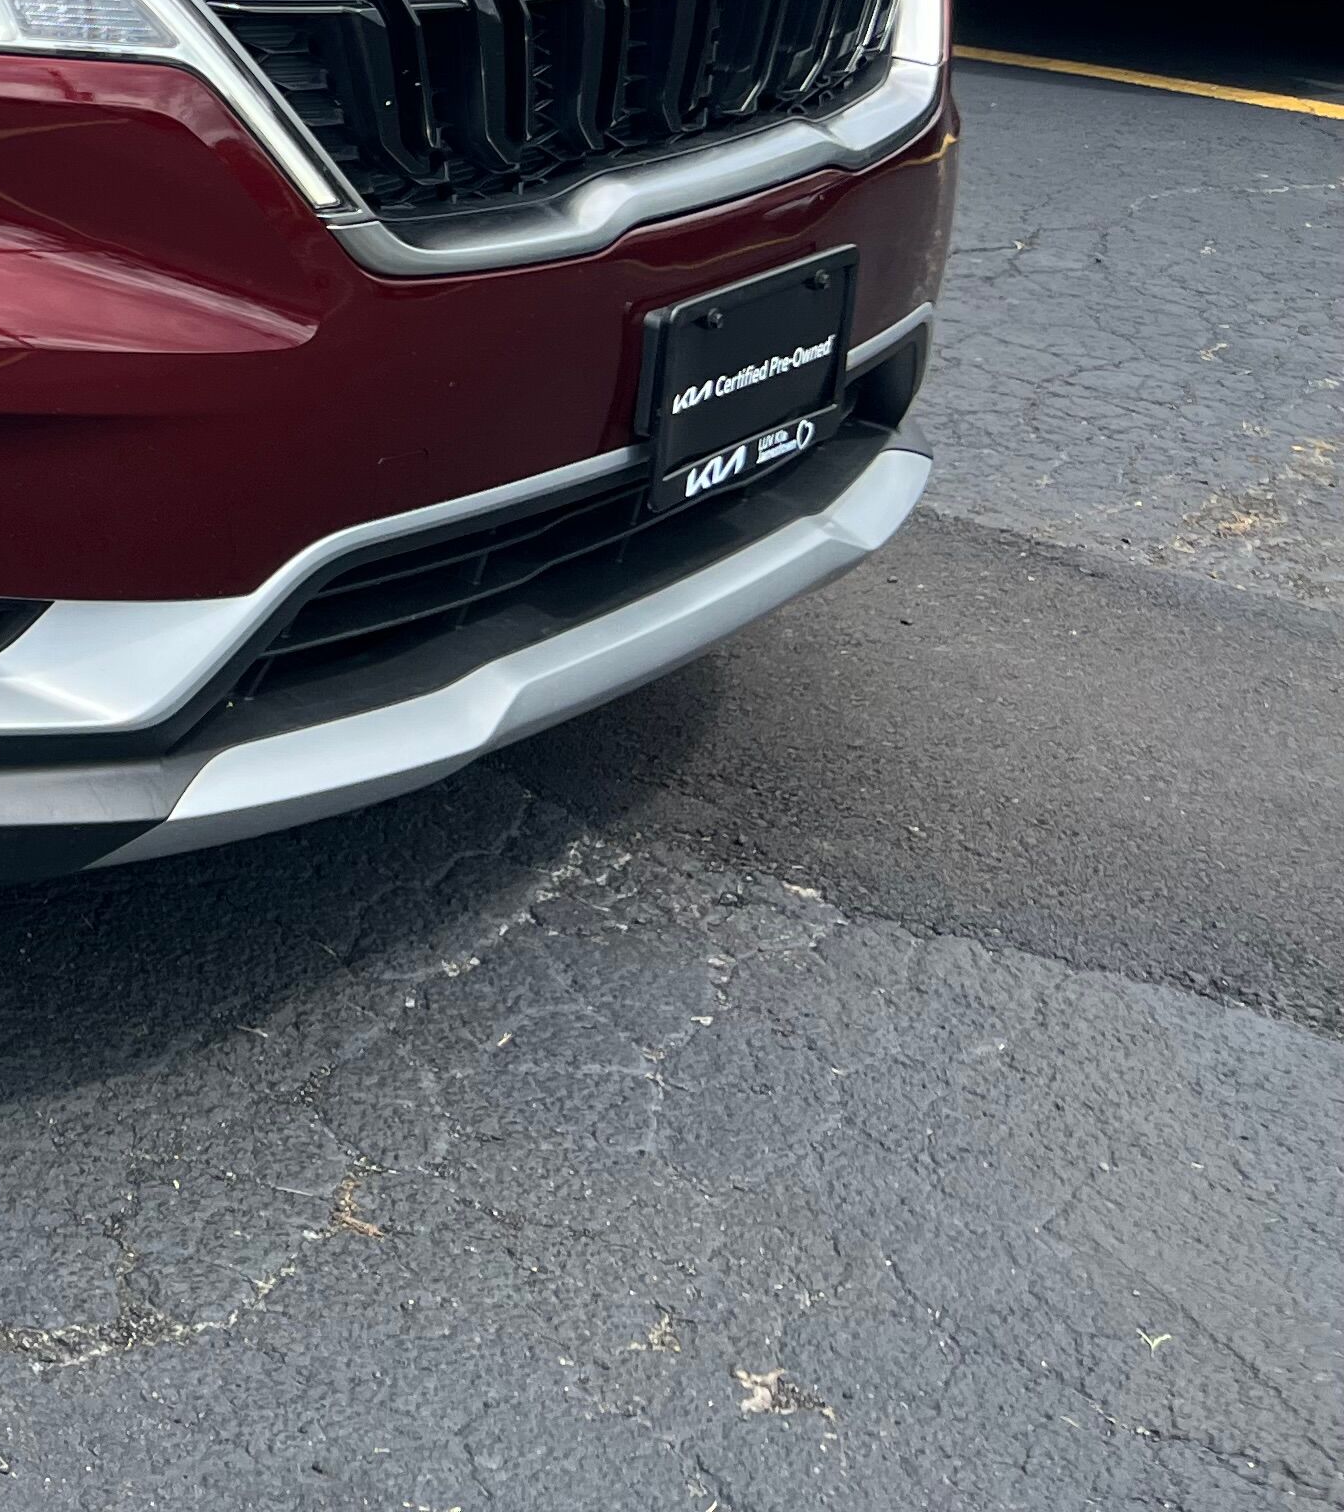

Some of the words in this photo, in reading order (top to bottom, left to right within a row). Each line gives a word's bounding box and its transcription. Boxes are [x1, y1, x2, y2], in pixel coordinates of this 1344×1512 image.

[672, 379, 714, 415] KIA
[715, 359, 769, 397] Certified
[685, 445, 748, 498] KIA
